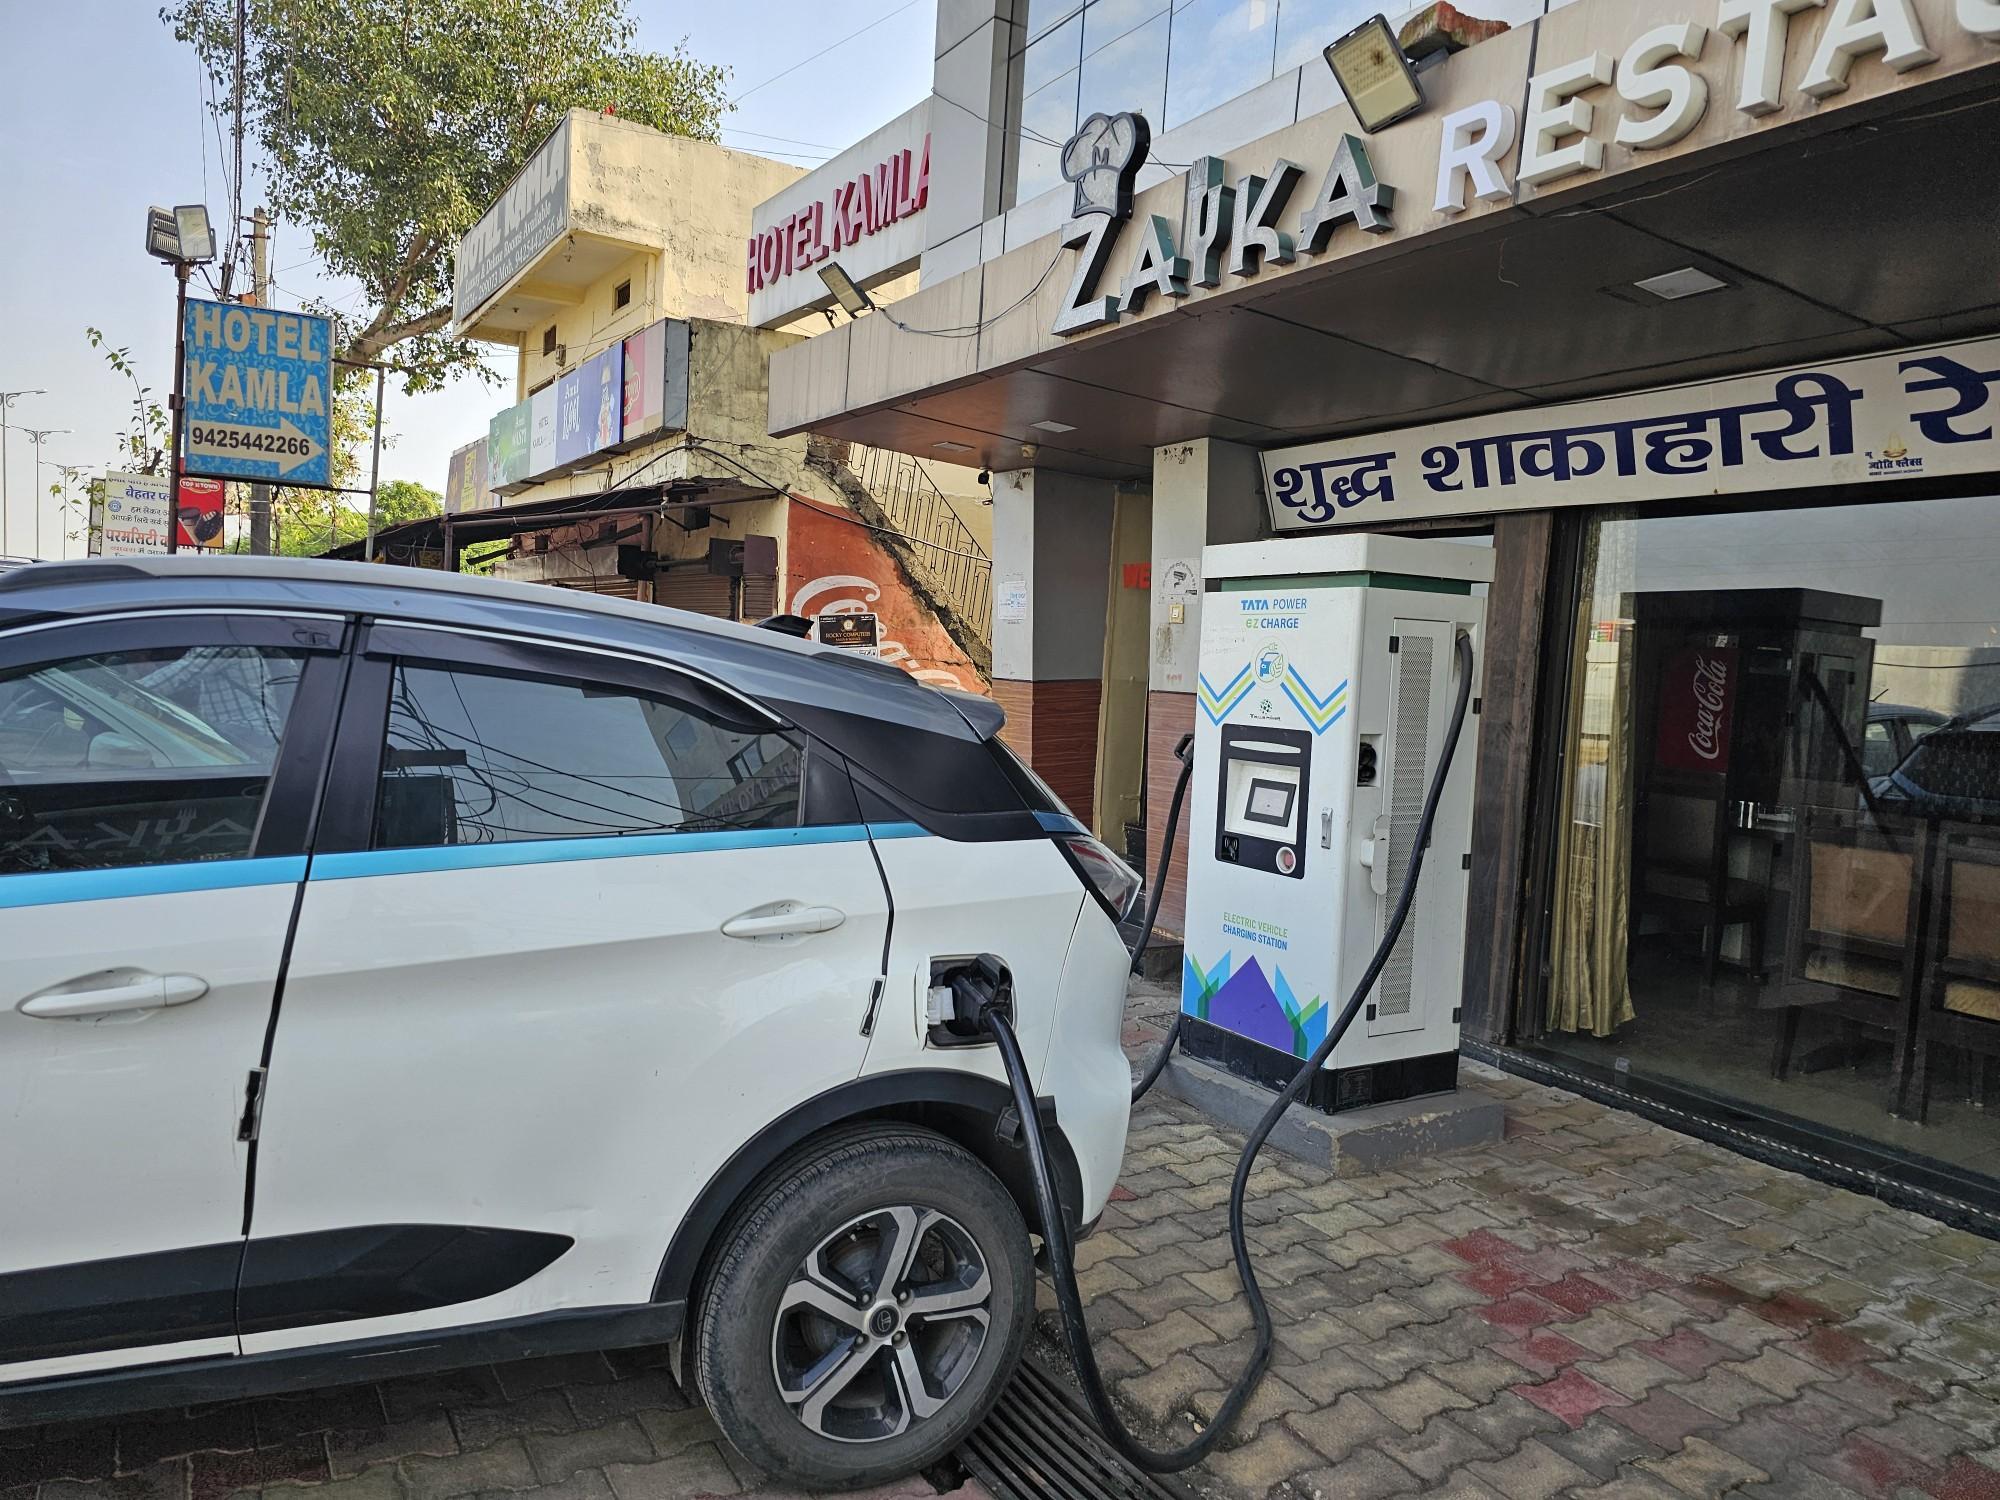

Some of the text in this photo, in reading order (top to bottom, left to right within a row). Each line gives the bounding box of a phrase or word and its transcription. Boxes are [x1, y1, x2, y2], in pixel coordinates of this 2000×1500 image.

[1432, 0, 2000, 216] RESTA
[459, 122, 566, 287] HOTEL KAMLA
[523, 199, 551, 240] Available
[746, 132, 932, 295] HOTEL KAMLA
[194, 303, 322, 362] HOTEL
[190, 360, 326, 417] KAMLA
[192, 426, 310, 456] 9425442266
[1273, 450, 1396, 523] शुद्ध
[1421, 372, 1863, 491] शाकाहारी
[1241, 598, 1307, 611] TATA POWER
[1260, 618, 1300, 629] CHARGE
[1688, 653, 1727, 760] Coca-Cola
[1223, 923, 1288, 951] CHARGING STATION
[1224, 912, 1288, 938] ELECTRIC VEHICLE
